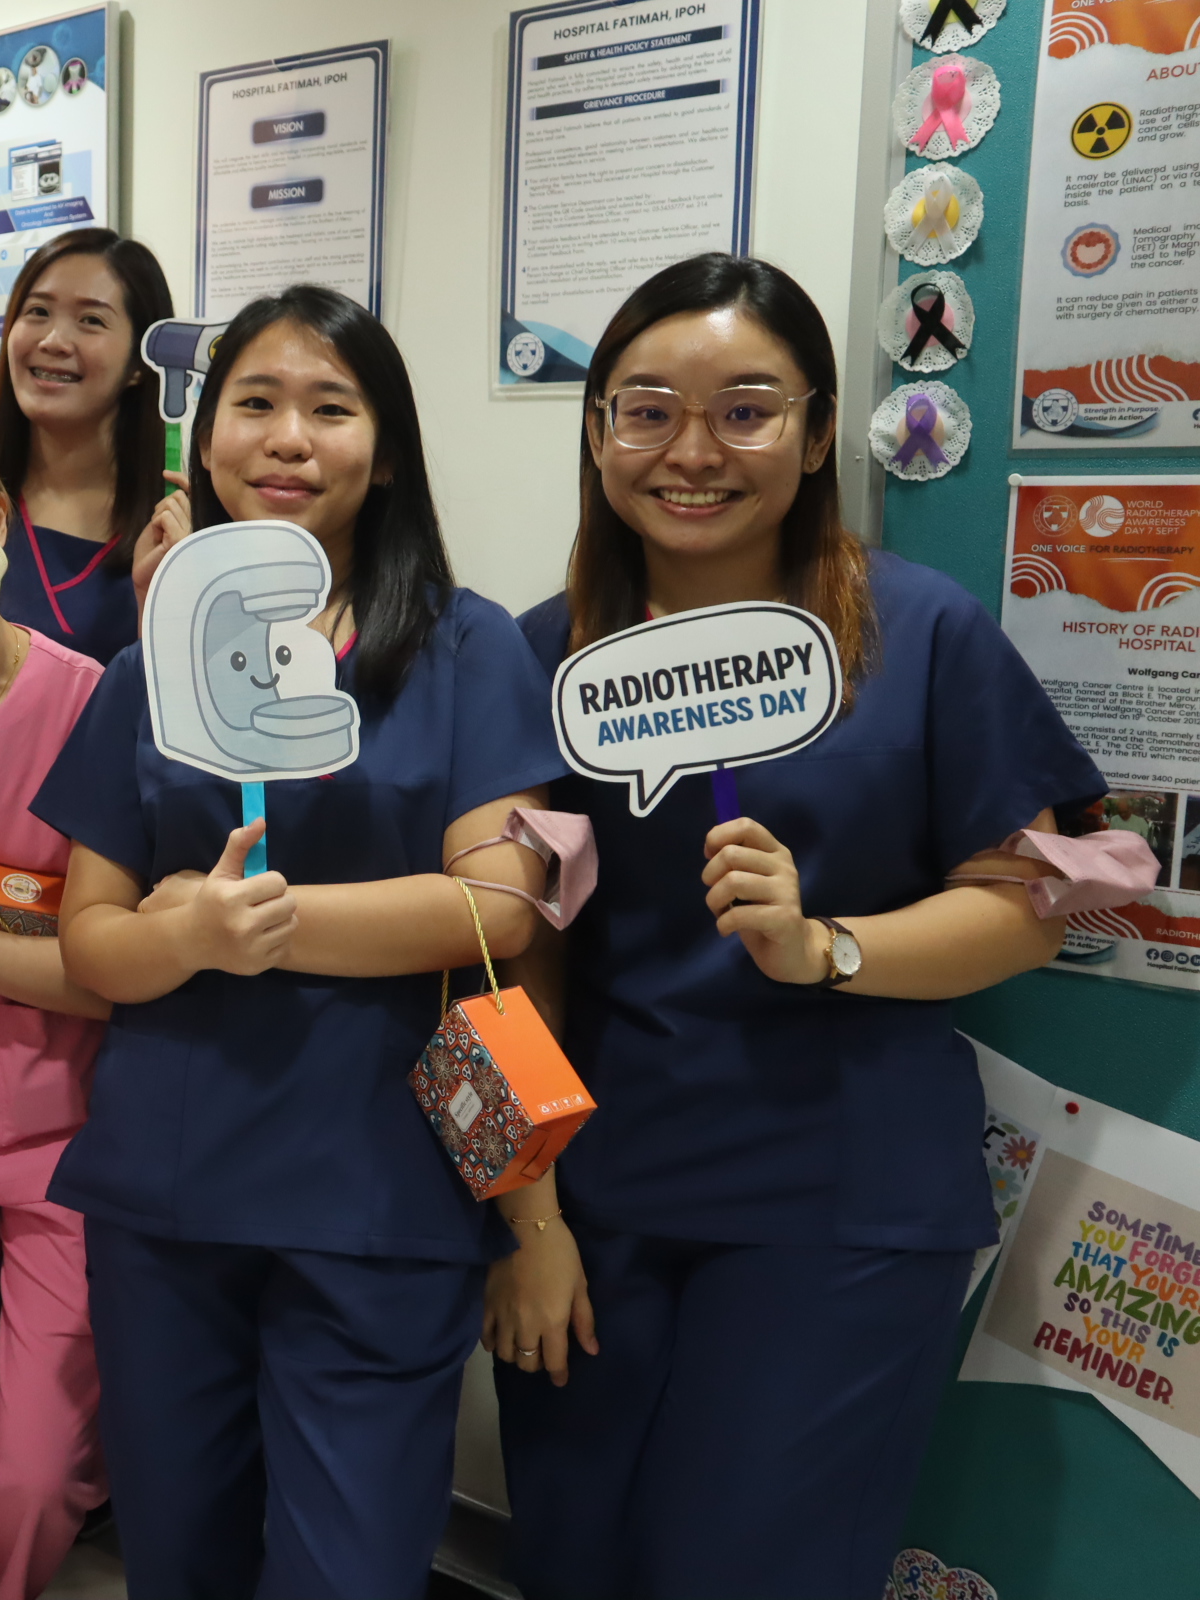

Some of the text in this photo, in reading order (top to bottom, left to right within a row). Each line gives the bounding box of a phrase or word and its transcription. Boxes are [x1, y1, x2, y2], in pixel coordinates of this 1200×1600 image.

[553, 4, 706, 40] HOSPITAL FATIMAH, IPOH
[564, 33, 692, 63] SAFETY & HEALTH POLICY STATEMENT
[1146, 62, 1200, 82] ABOU
[232, 72, 348, 99] HOSPITAL FATIMAH, IPOH
[584, 90, 666, 110] GRIEVANCE PROCEDURE
[273, 120, 304, 134] VISION
[1138, 118, 1156, 126] use
[1138, 120, 1200, 134] cancer cells
[1137, 132, 1186, 142] and grow.
[1077, 174, 1098, 182] may
[1122, 165, 1166, 176] delivered
[1172, 162, 1200, 172] using
[1065, 180, 1119, 190] Accelerator
[1122, 174, 1157, 186] (LINAC)
[268, 186, 306, 200] MISSION
[1064, 191, 1092, 199] inside
[1098, 188, 1113, 196] the
[1120, 184, 1154, 196] patient
[1160, 182, 1173, 190] on
[1064, 200, 1090, 208] basis.
[1133, 225, 1172, 236] Medical
[1133, 232, 1196, 244] Tomography
[1131, 252, 1154, 260] used
[1174, 248, 1196, 258] help
[1132, 242, 1156, 253] (PET)
[1148, 259, 1184, 268] cancer.
[1066, 296, 1083, 304] can
[1086, 294, 1118, 302] reduce
[1122, 292, 1143, 301] pain
[1146, 290, 1154, 298] in
[1158, 288, 1198, 298] patients
[1056, 304, 1074, 312] and
[1078, 304, 1098, 312] may
[1116, 300, 1142, 310] given
[1160, 298, 1189, 306] either
[1056, 312, 1074, 320] with
[1076, 310, 1111, 320] surgery
[1126, 305, 1199, 316] chemotherapy.
[1127, 500, 1164, 508] WORLD
[1126, 509, 1200, 518] RADIOTHERAPY
[1125, 518, 1186, 526] AWARENESS
[1031, 544, 1053, 552] ONE
[1056, 545, 1086, 553] VOICE
[1113, 546, 1194, 554] RADIOTHERAPY
[1062, 622, 1128, 634] HISTORY
[1133, 624, 1156, 636] OF
[1118, 638, 1196, 652] HOSPITAL
[579, 642, 813, 716] RADIOTHERAPY
[1128, 668, 1179, 680] Wolfgang
[1040, 678, 1078, 689] Wolfgang
[1148, 684, 1154, 692] is
[1158, 686, 1190, 694] located
[1045, 687, 1072, 695] ospital,
[1102, 704, 1142, 714] Wolfgang
[1169, 702, 1196, 710] Mercy,
[598, 687, 808, 747] AWARENESS DAY
[1074, 710, 1118, 719] completed
[1147, 715, 1181, 723] October
[1083, 725, 1116, 734] consists
[1162, 731, 1194, 740] namely
[1102, 748, 1112, 756] by
[1150, 752, 1175, 760] which
[1147, 962, 1174, 970] Hospital
[1079, 1220, 1126, 1252] YOU
[1072, 1241, 1200, 1315] THAT YOU'R
[1053, 1257, 1200, 1345] AMAZING
[1064, 1292, 1180, 1358] SO THIS IS
[1082, 1316, 1146, 1364] YOUR
